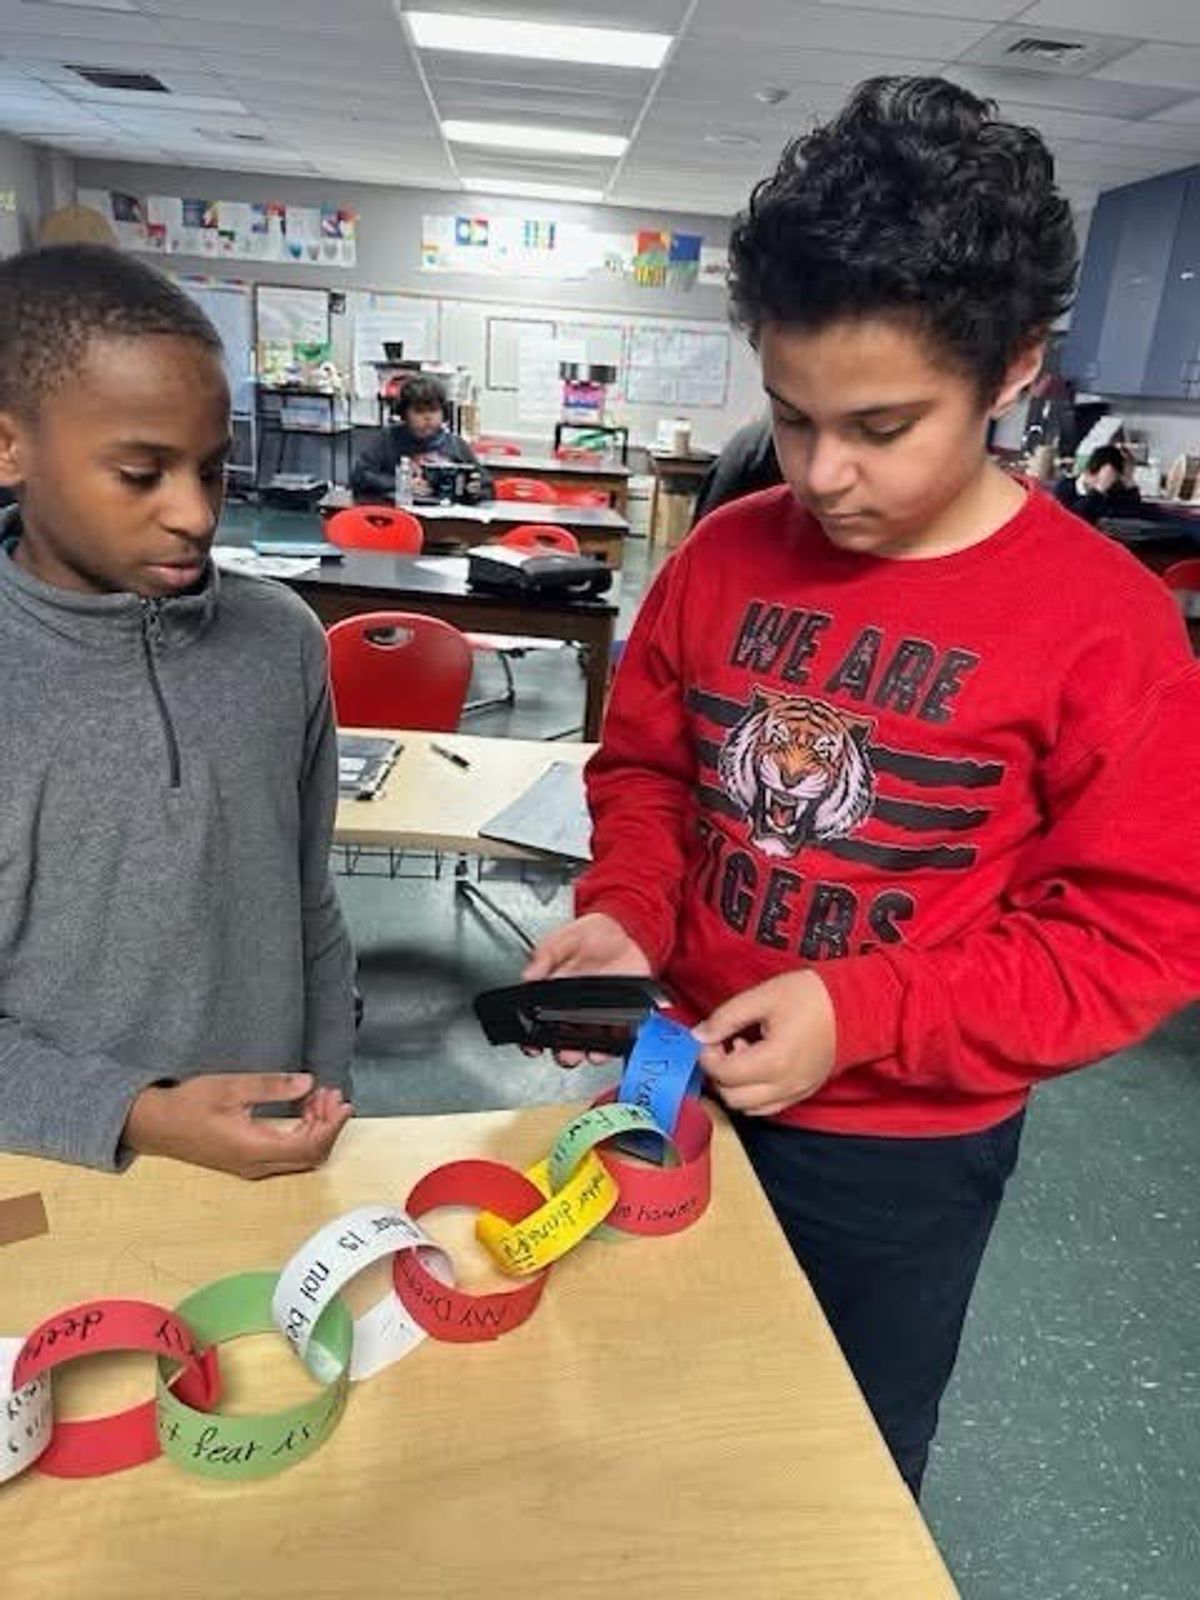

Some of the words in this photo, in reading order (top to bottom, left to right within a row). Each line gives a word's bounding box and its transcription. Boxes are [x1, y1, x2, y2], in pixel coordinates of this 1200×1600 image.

[729, 599, 833, 685] WE
[825, 626, 980, 724] ARE
[191, 1425, 261, 1465] fear
